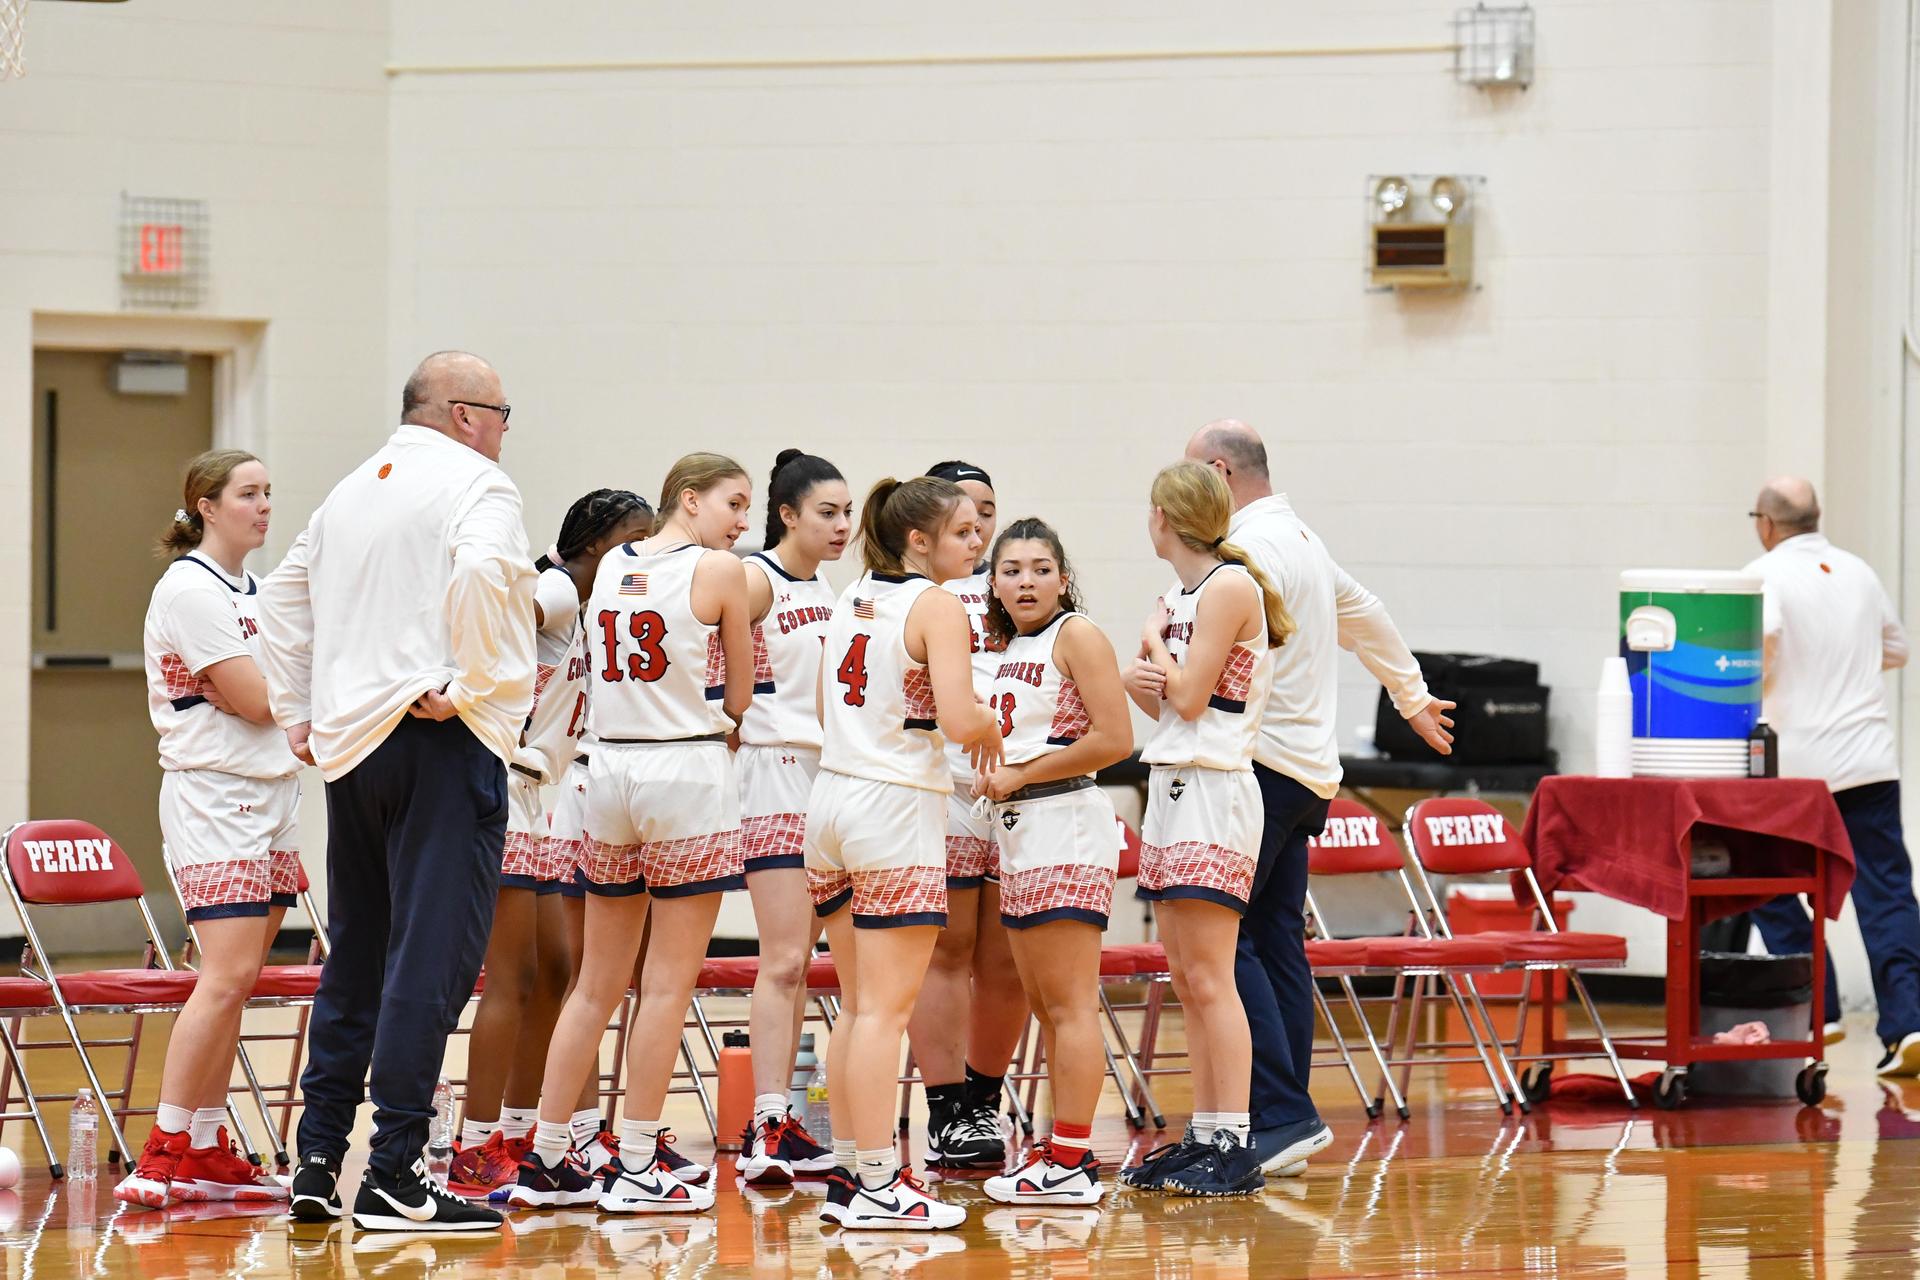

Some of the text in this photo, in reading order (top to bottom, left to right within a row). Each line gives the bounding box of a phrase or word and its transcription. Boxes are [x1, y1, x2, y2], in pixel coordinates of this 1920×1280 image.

[139, 223, 184, 272] EXIT
[598, 610, 671, 682] 13
[837, 633, 870, 708] 4
[1308, 816, 1381, 848] ERRY
[1424, 813, 1508, 847] PERRY
[22, 838, 114, 873] PERRY
[310, 1155, 327, 1165] NIKE
